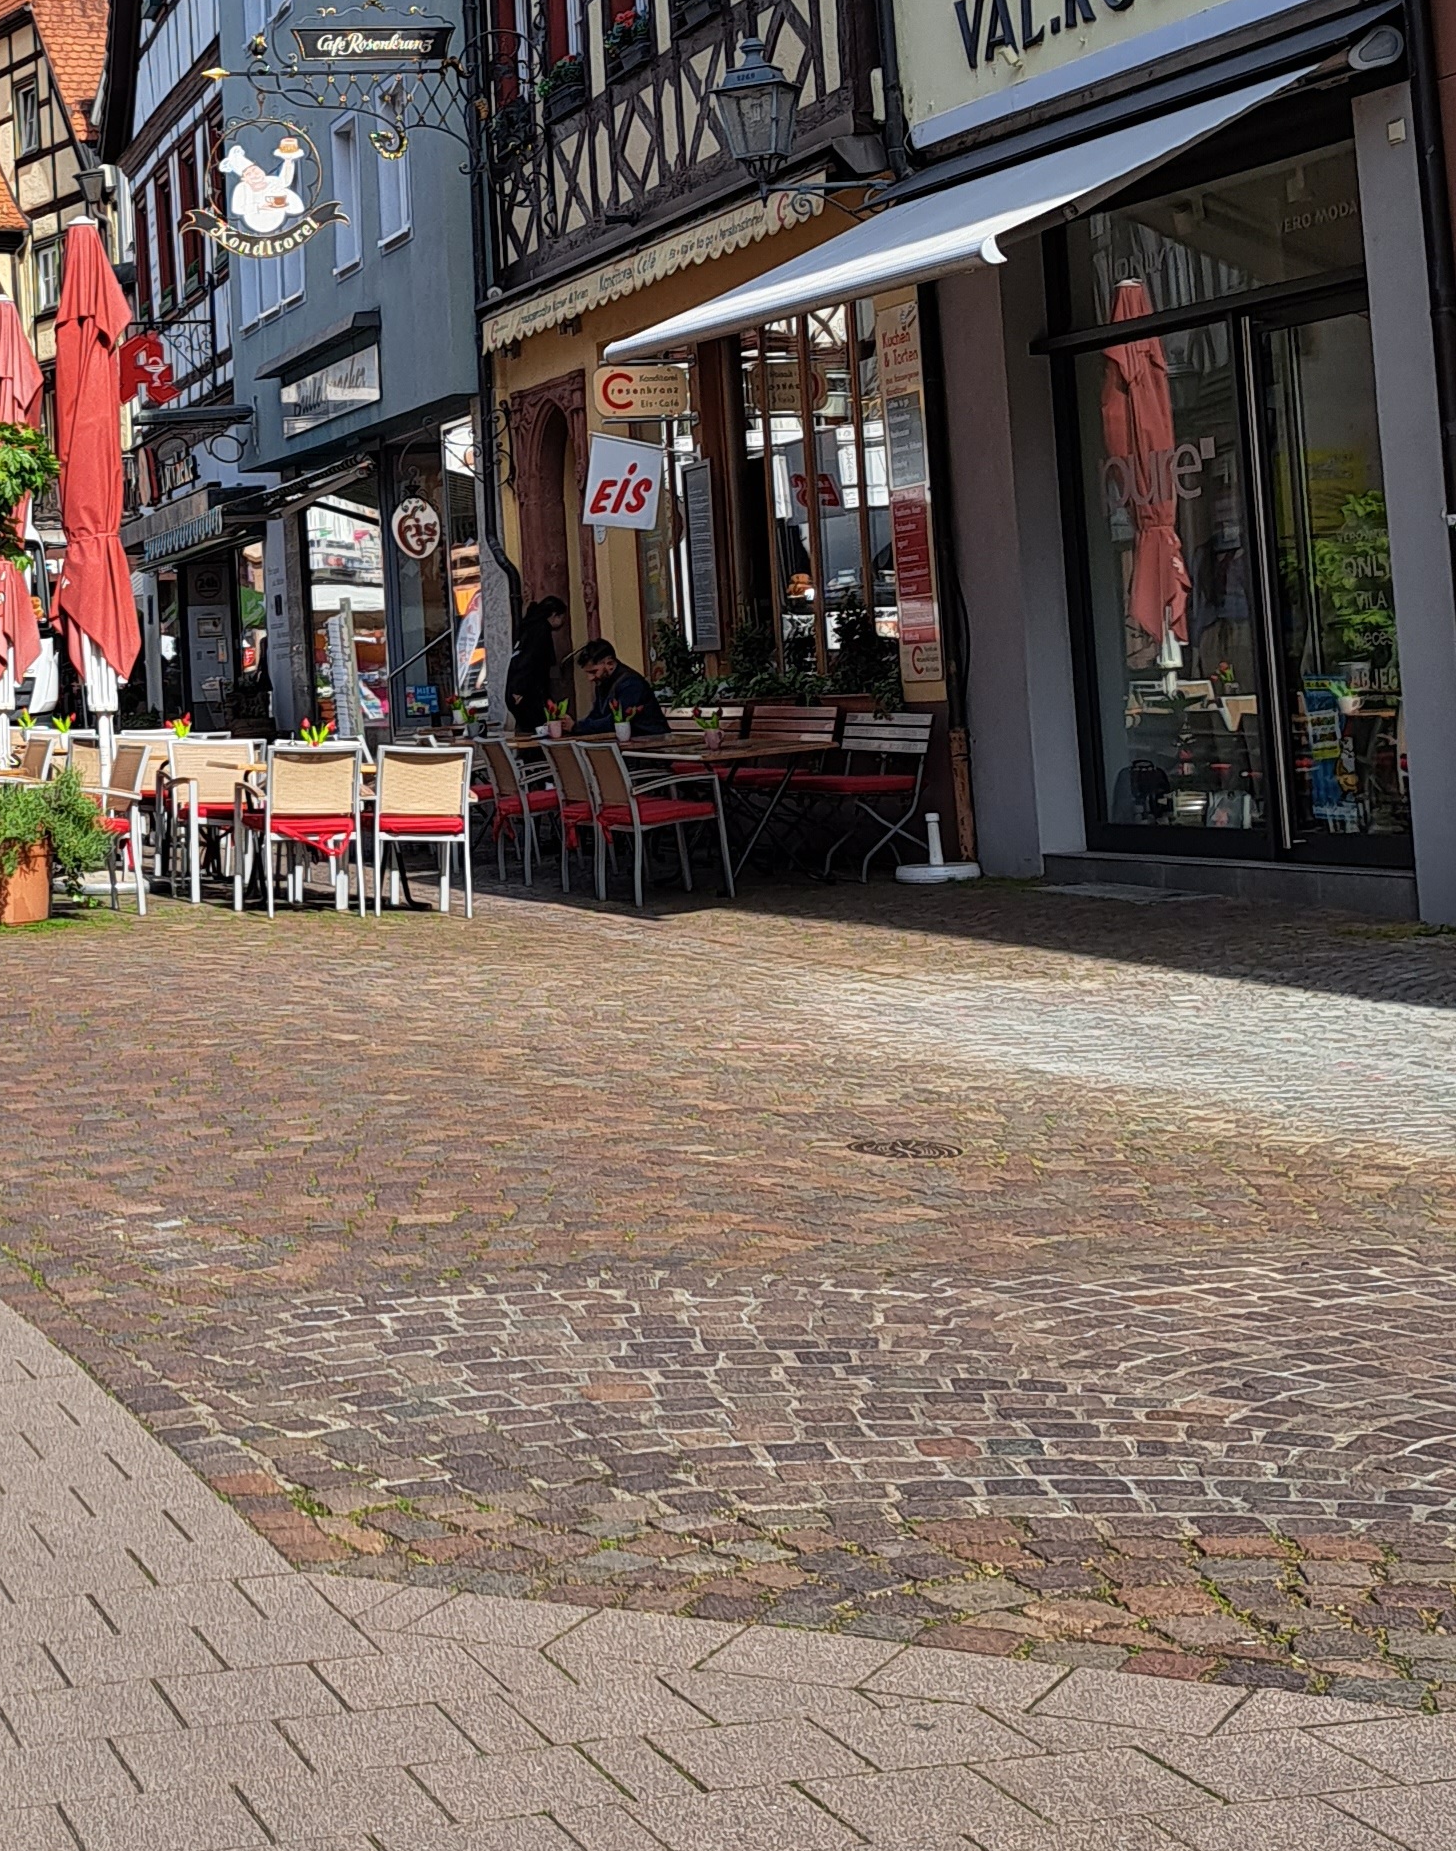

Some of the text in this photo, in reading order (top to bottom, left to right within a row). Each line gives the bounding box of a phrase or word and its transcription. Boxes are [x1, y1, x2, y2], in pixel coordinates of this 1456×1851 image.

[337, 31, 435, 56] Rosenkranz
[210, 216, 321, 257] Konditorei
[1098, 443, 1203, 517] pure
